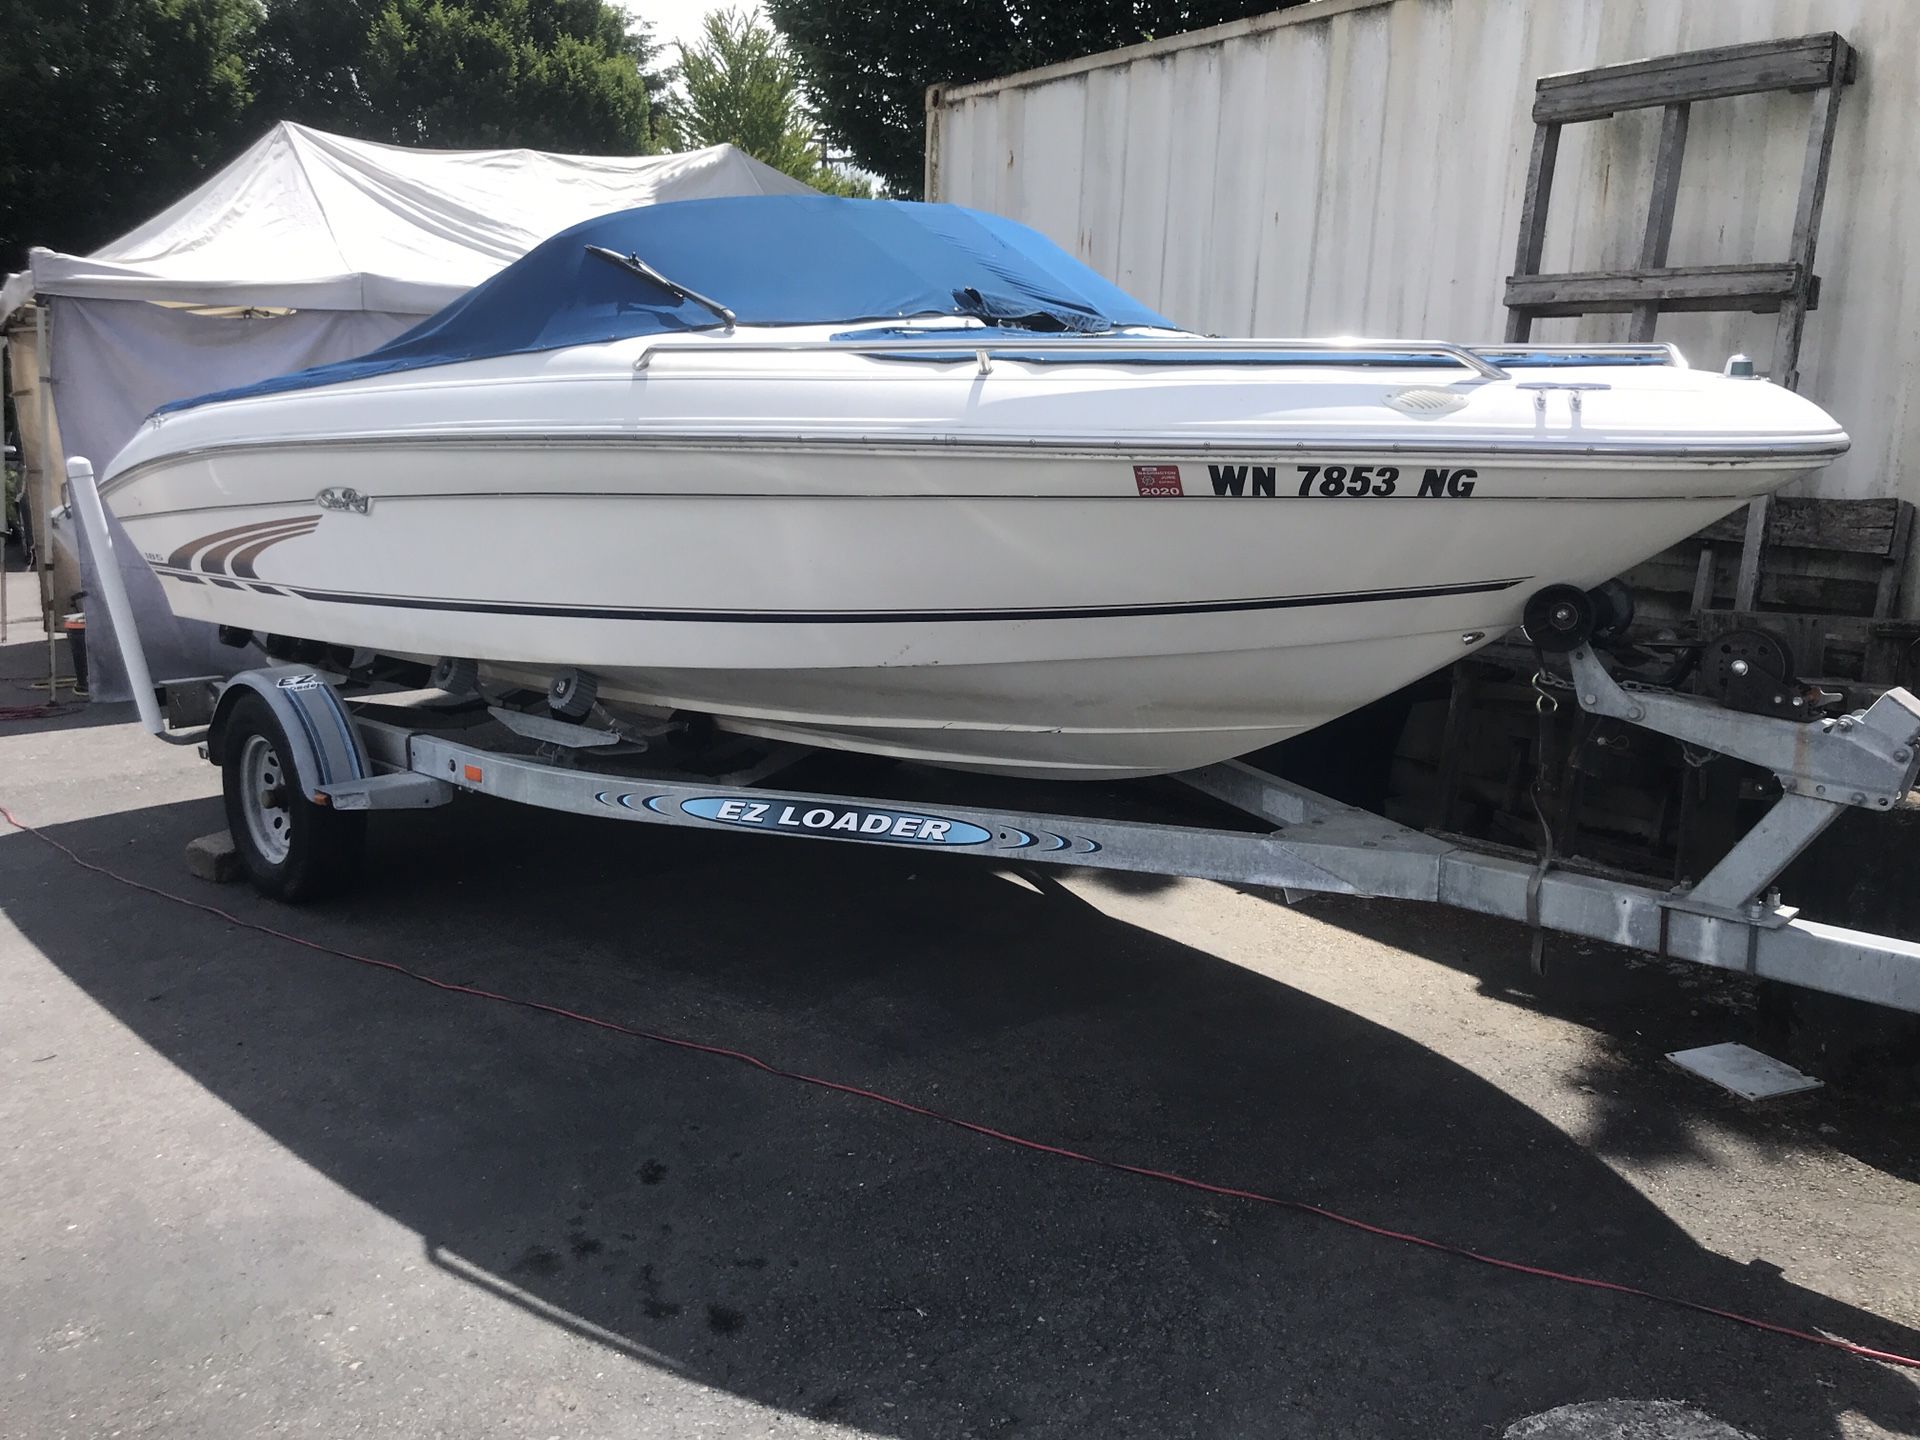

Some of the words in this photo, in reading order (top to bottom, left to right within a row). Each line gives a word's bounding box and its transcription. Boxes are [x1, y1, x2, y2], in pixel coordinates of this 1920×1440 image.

[1140, 487, 1180, 496] 2020
[1207, 465, 1276, 496] WN
[1297, 466, 1400, 497] 7853
[1417, 469, 1478, 498] NG
[278, 674, 316, 687] EZ
[716, 801, 770, 823] EZ
[777, 806, 951, 841] LOADER
